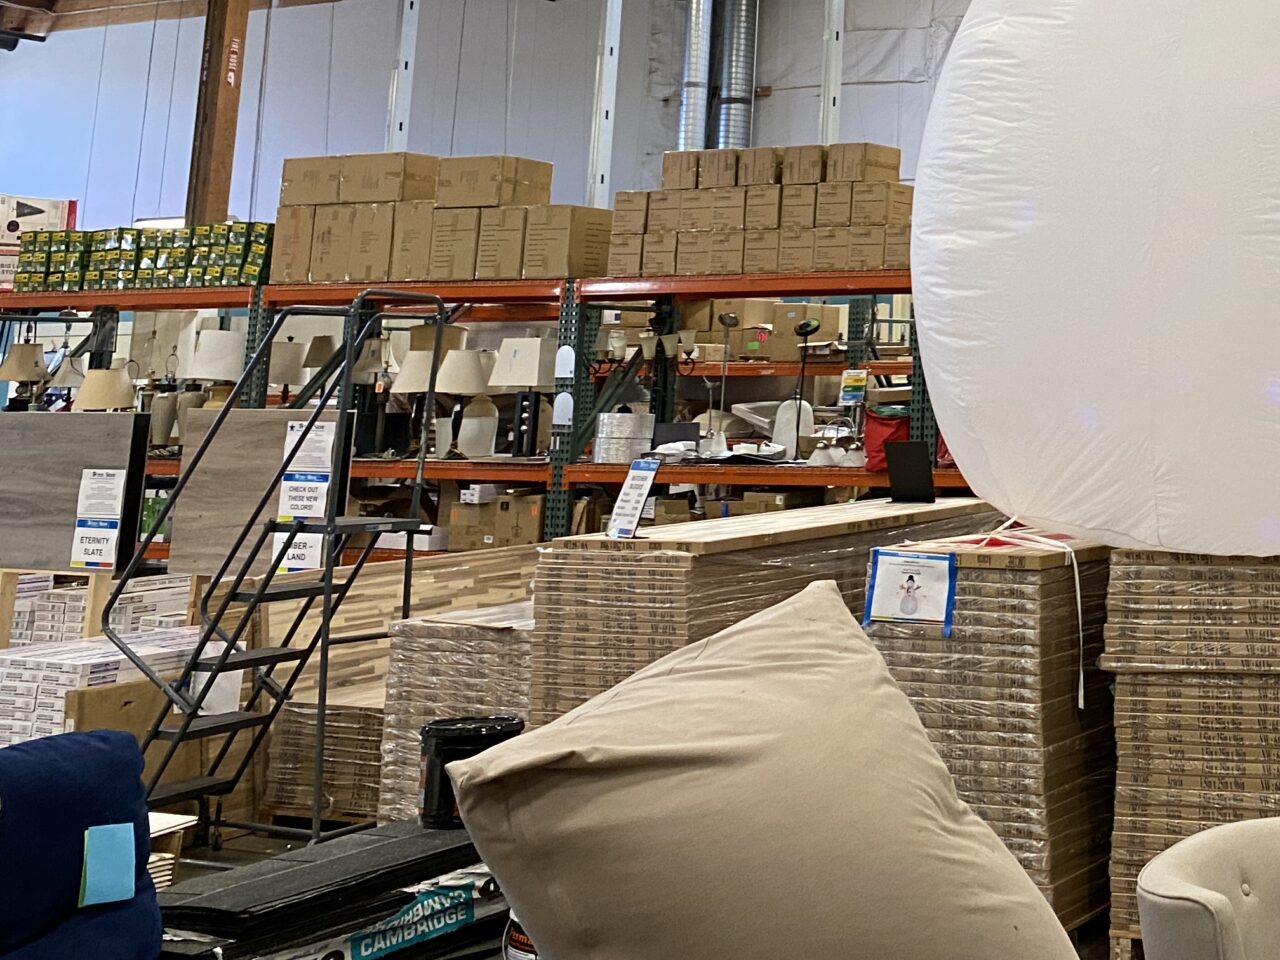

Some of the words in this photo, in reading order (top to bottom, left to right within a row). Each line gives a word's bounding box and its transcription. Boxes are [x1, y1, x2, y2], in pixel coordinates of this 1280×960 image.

[80, 536, 110, 545] ETERNITY
[83, 548, 103, 557] SLATE
[287, 553, 306, 561] LAND
[360, 904, 468, 958] CAMBRIDGE
